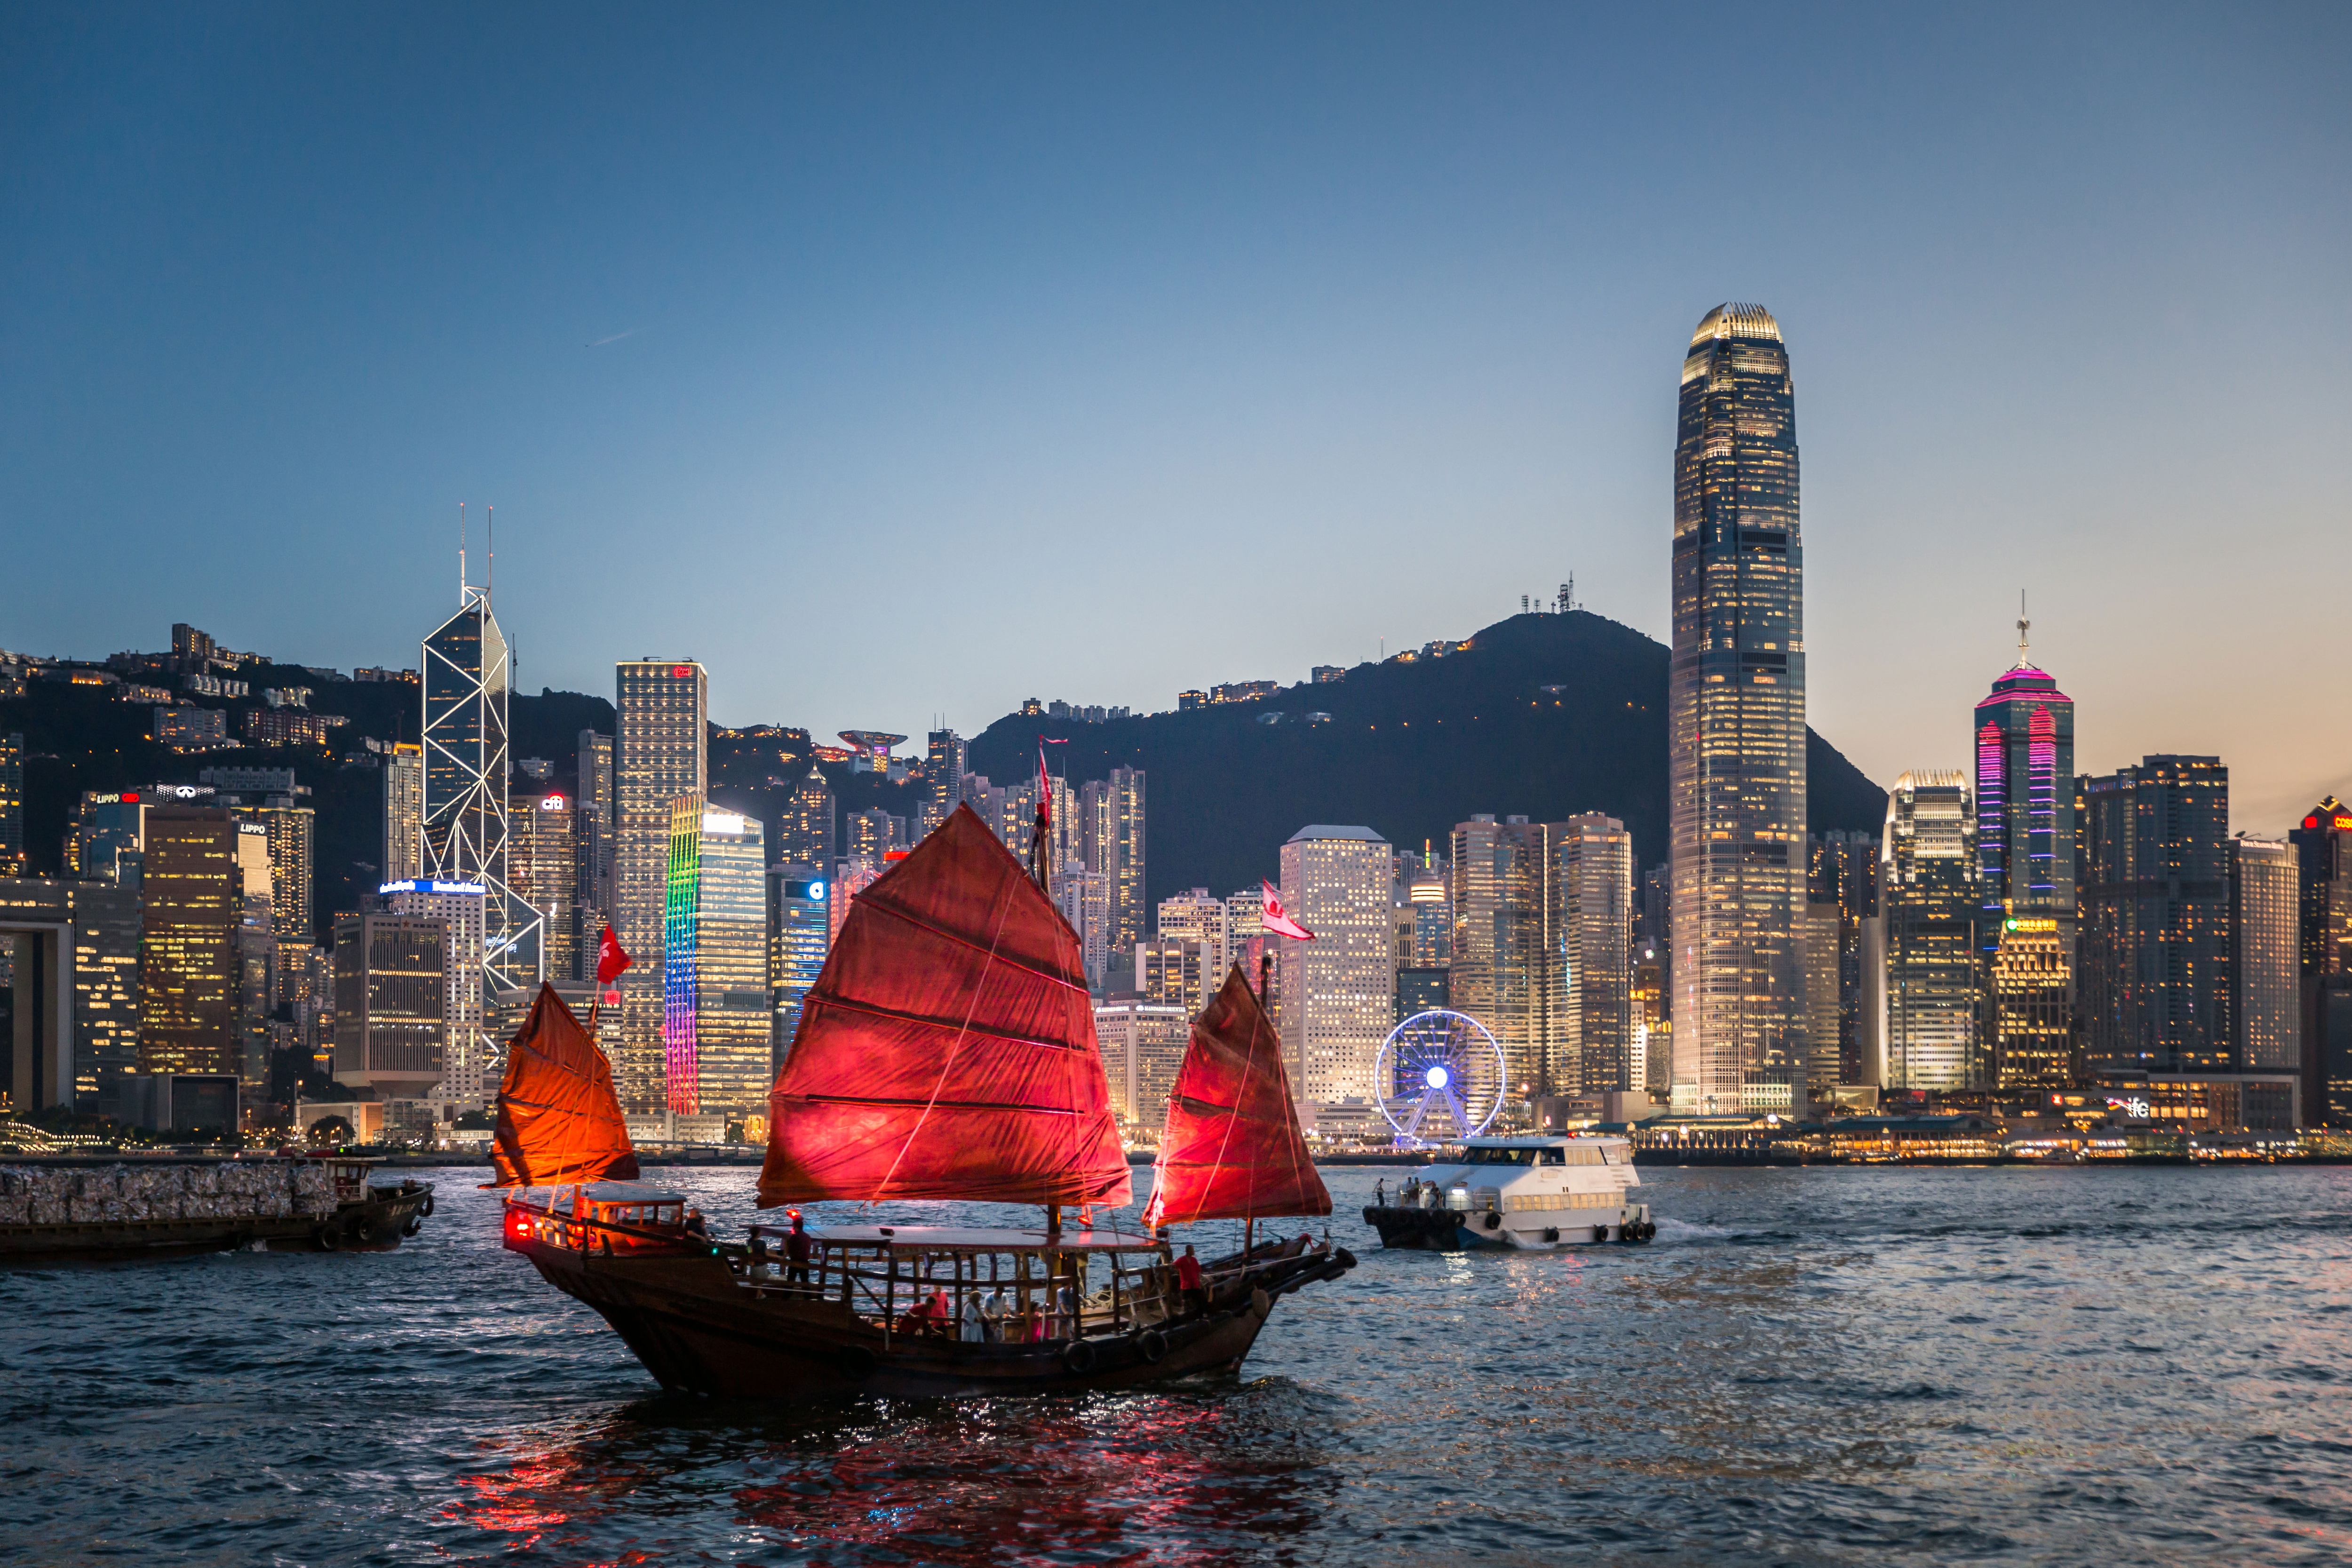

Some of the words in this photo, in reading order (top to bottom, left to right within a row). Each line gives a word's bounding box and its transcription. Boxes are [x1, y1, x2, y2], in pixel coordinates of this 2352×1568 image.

[97, 794, 119, 804] LIPPO
[240, 823, 265, 834] LIPPO
[2128, 1097, 2149, 1118] ifc
